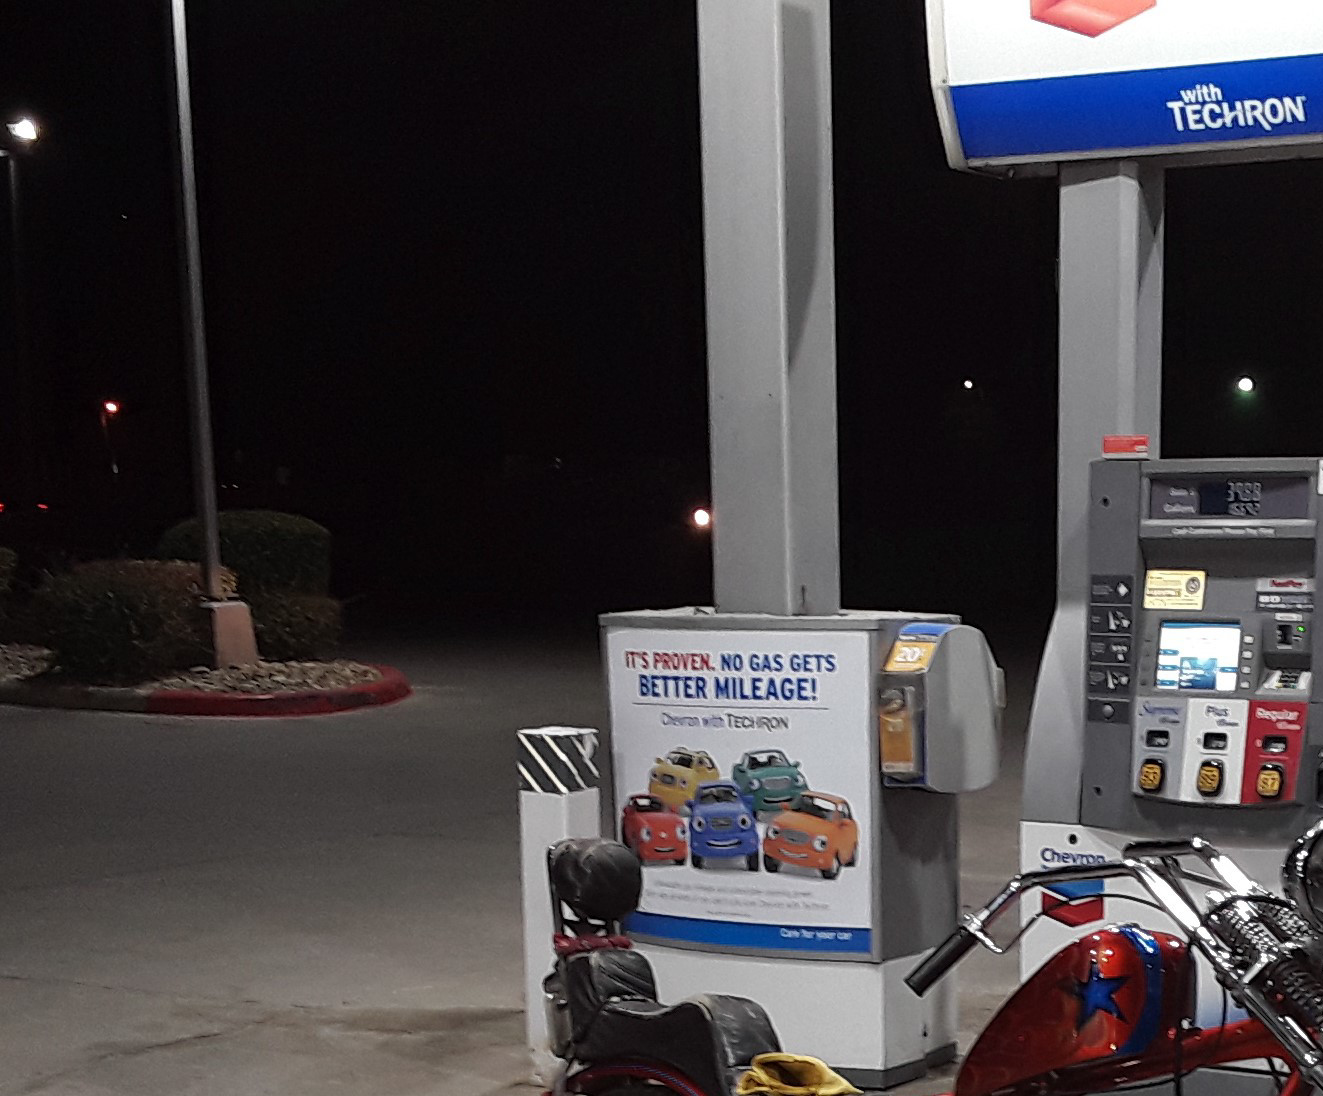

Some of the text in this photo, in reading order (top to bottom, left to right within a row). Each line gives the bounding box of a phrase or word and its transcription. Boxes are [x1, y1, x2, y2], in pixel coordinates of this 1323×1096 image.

[1179, 82, 1223, 103] with
[1165, 95, 1307, 131] TECHRON
[625, 650, 837, 673] IT'S PROVEN. NO GAS GETS
[638, 673, 818, 701] BETTER MILEAGE!
[726, 712, 790, 732] TECHRON
[1040, 847, 1105, 866] Chevron
